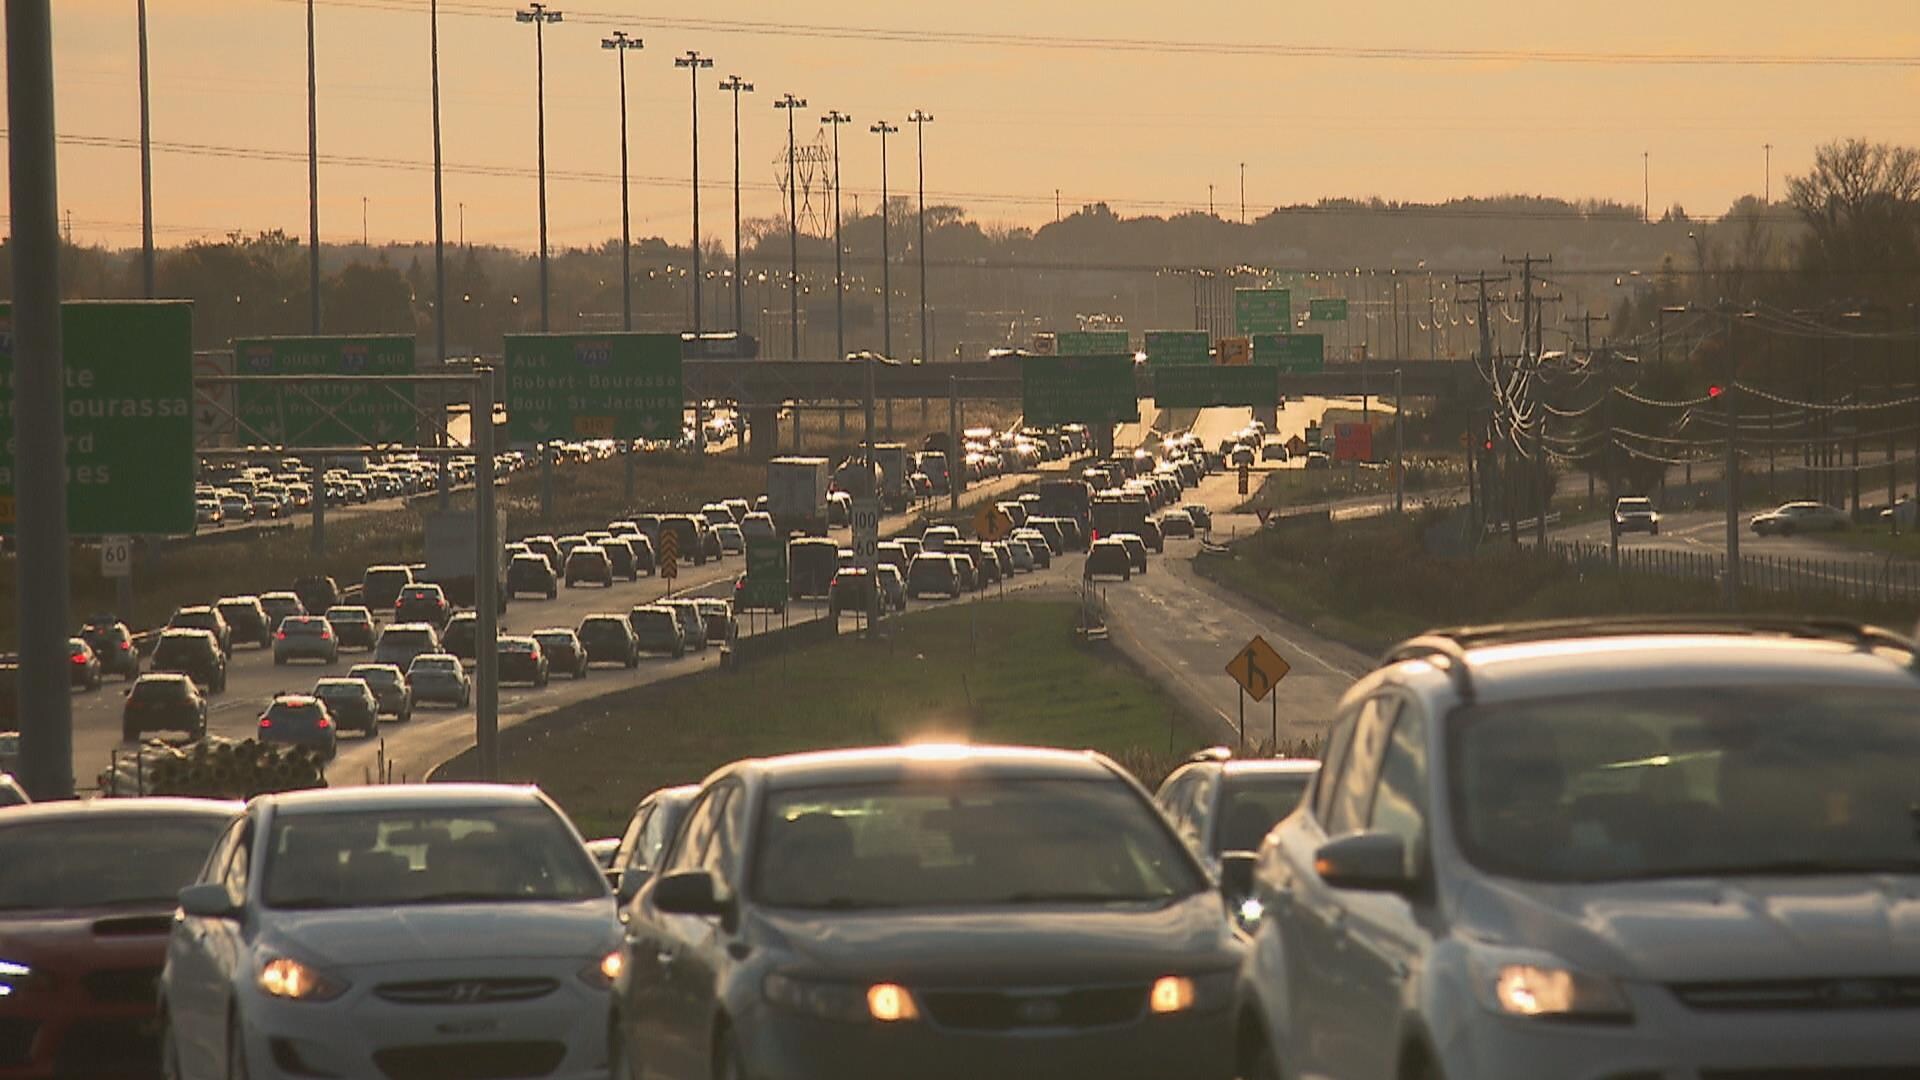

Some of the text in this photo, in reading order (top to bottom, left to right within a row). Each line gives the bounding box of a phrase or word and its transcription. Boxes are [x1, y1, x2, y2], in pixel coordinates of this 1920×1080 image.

[854, 512, 875, 529] 100
[106, 545, 126, 562] 60
[856, 541, 875, 557] 60
